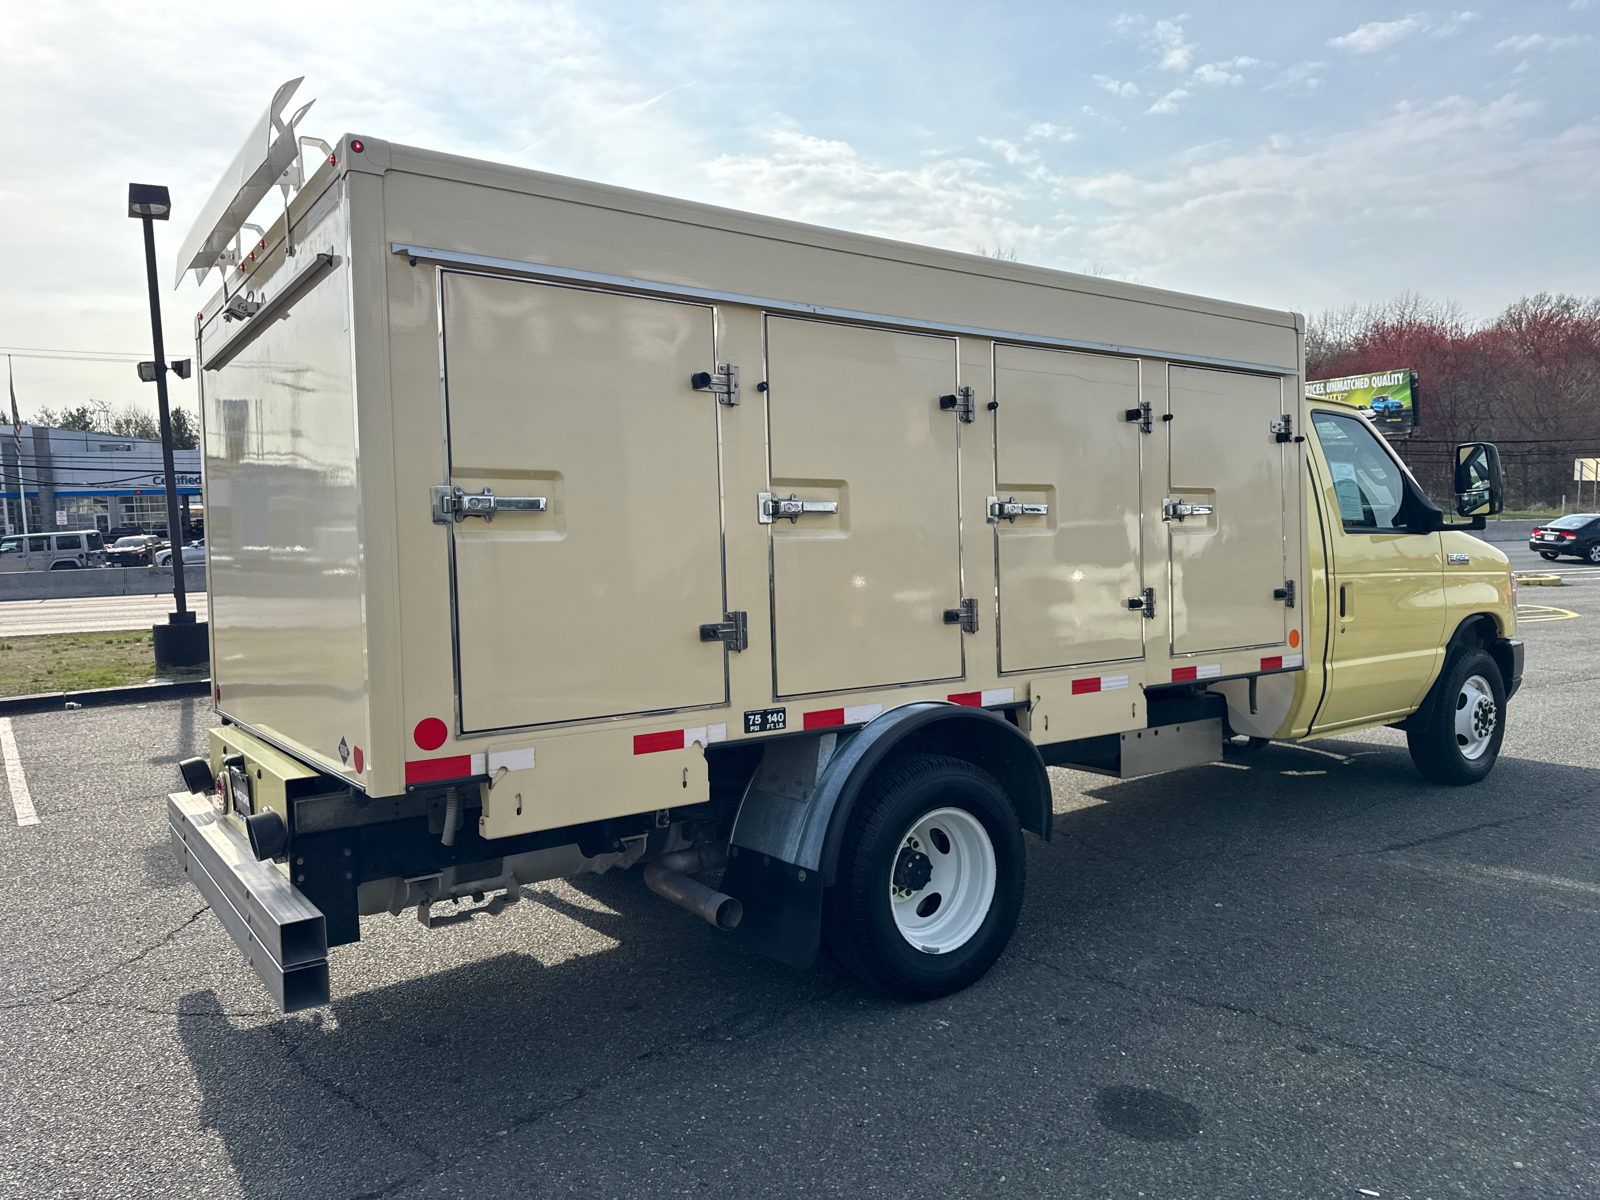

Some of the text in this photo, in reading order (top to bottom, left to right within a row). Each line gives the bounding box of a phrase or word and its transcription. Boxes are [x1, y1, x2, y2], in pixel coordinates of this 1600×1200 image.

[1326, 379, 1369, 392] UNMATCHED
[1371, 373, 1404, 387] QUALITY
[153, 475, 202, 485] Ceified
[748, 714, 761, 725] 75
[767, 712, 784, 723] 140
